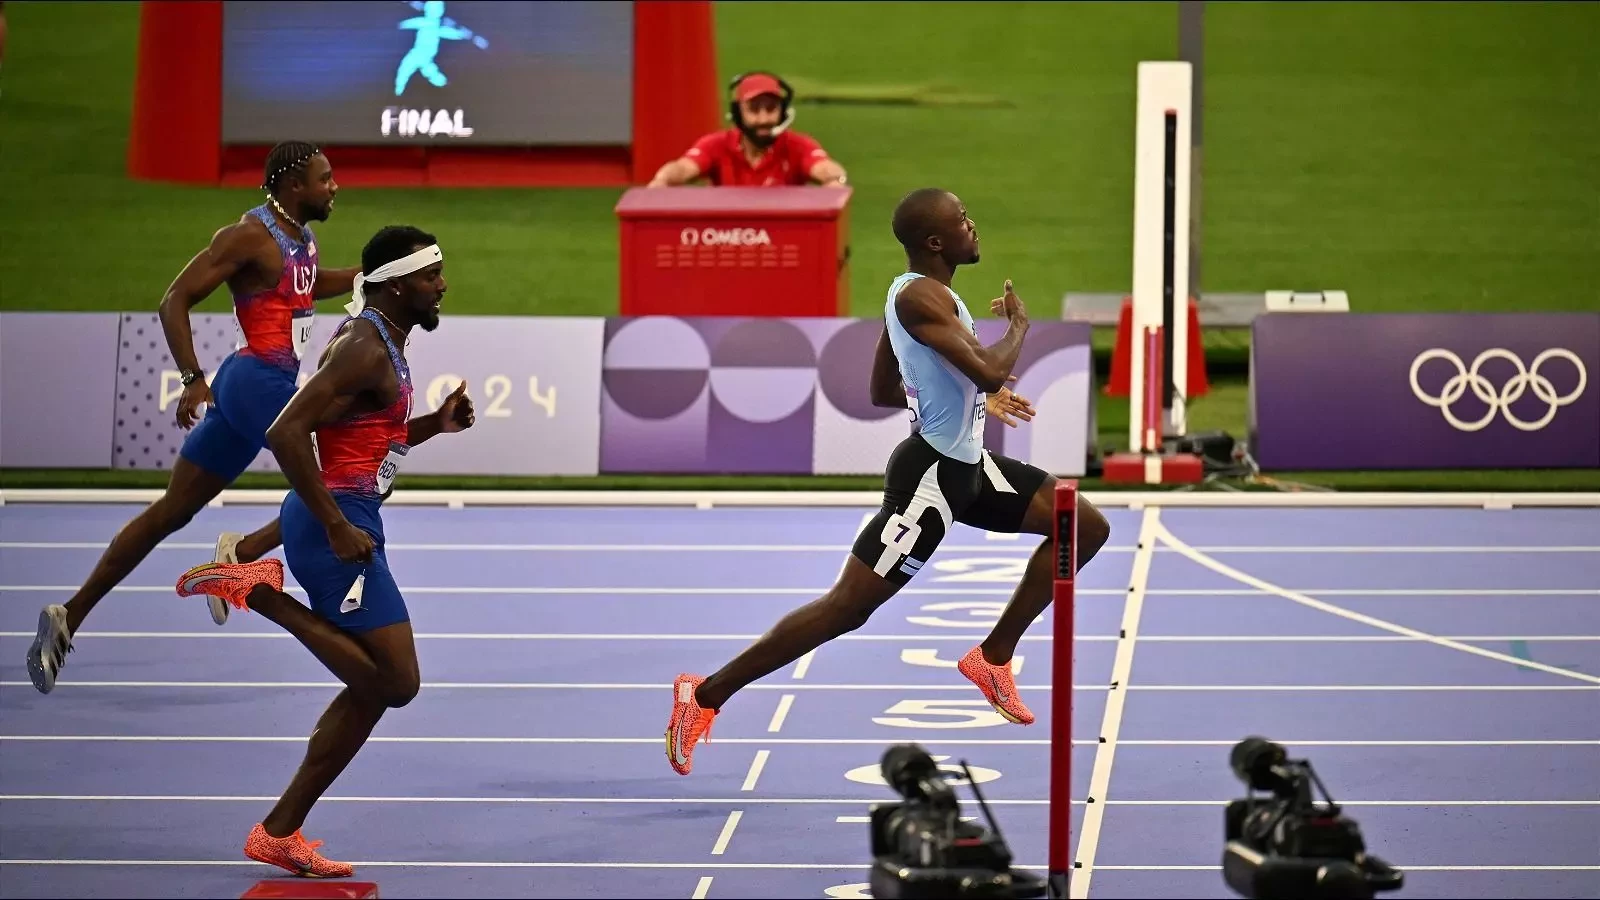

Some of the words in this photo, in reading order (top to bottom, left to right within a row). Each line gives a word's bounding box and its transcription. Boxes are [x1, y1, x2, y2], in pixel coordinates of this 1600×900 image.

[381, 107, 474, 138] FINAL
[701, 228, 771, 246] OMEGA
[378, 459, 399, 480] BED
[893, 522, 911, 544] 7
[871, 699, 1010, 729] 5
